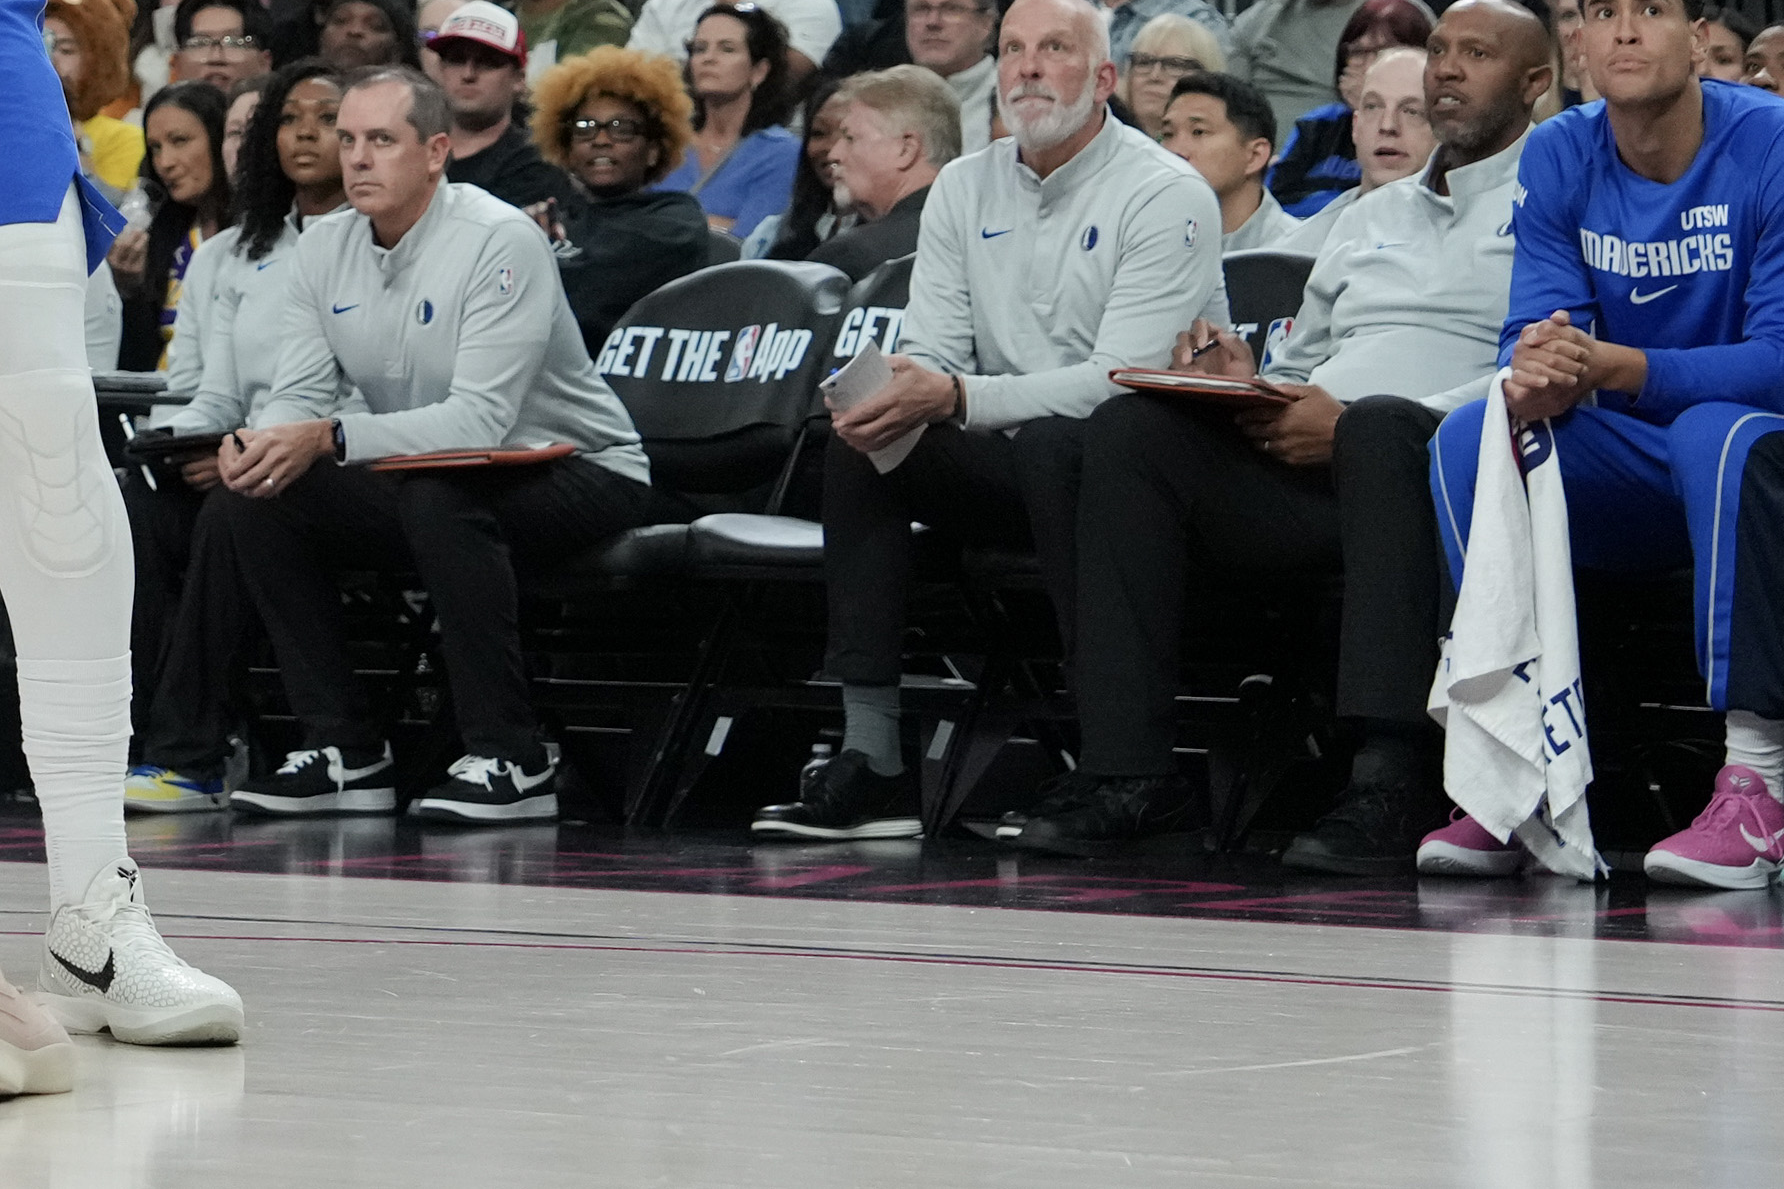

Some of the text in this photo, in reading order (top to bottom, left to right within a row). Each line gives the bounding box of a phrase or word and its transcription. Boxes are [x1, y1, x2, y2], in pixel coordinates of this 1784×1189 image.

[1680, 203, 1729, 231] UTSW
[599, 322, 813, 383] GET THE App
